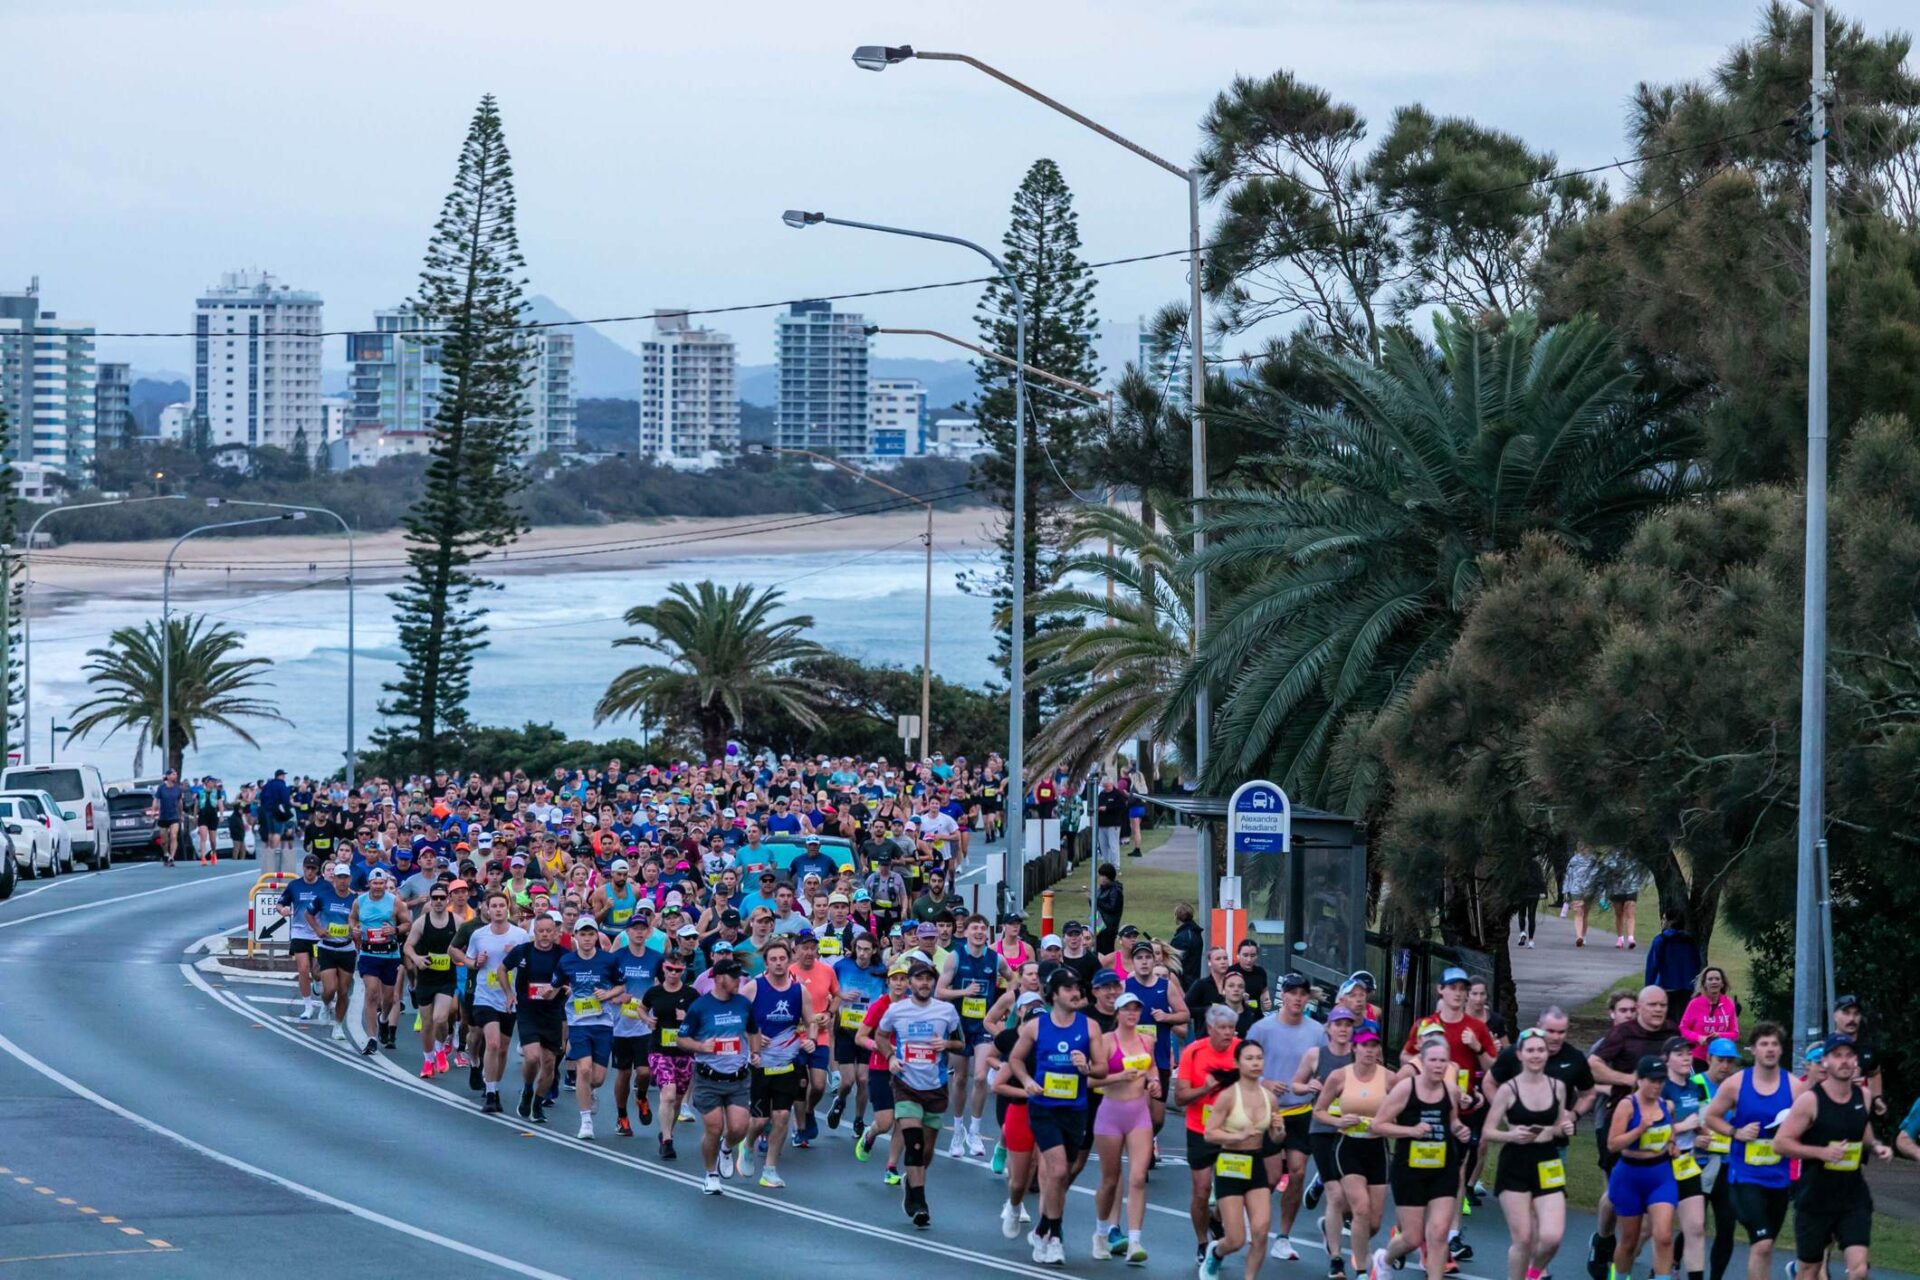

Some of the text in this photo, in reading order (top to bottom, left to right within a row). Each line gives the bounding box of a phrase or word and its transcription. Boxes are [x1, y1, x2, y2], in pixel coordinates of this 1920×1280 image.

[1241, 815, 1278, 823] Alexandra
[1241, 824, 1278, 832] Headland
[261, 897, 279, 905] KEE
[261, 907, 278, 916] LEF
